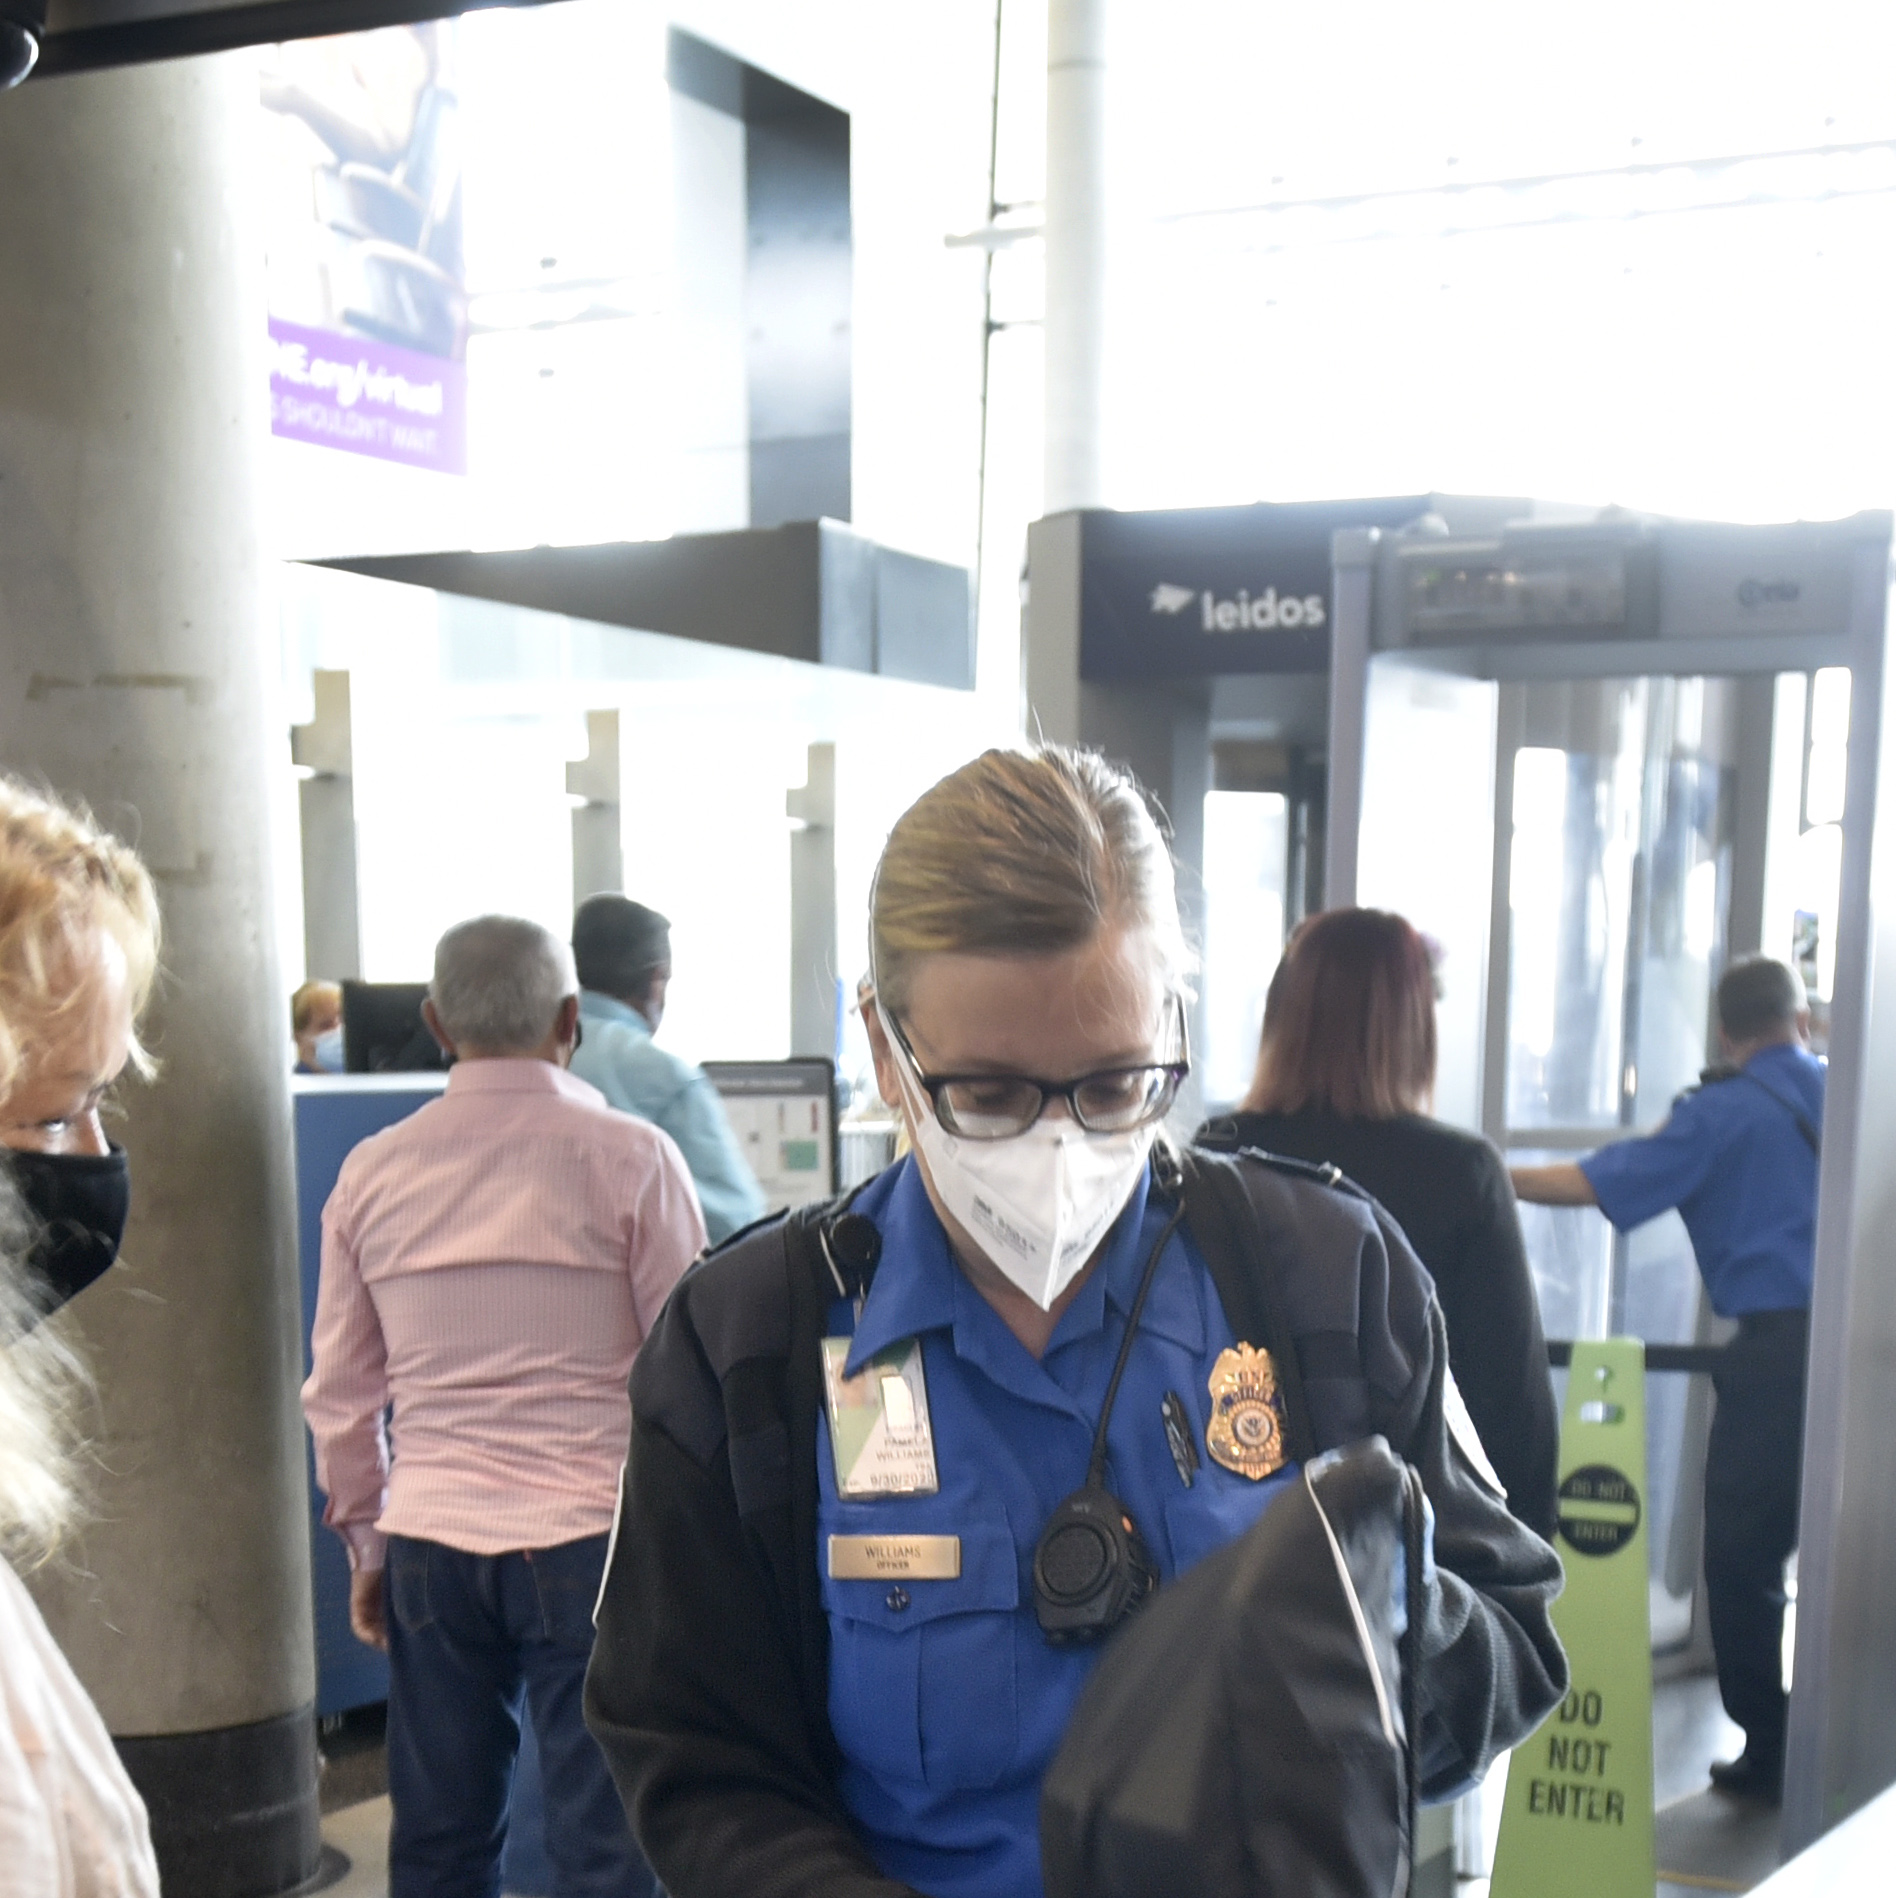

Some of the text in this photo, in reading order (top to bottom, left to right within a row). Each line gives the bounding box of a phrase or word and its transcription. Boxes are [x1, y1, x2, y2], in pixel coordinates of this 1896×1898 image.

[1201, 585, 1325, 631] leidos
[1571, 1478, 1625, 1500] DO NOT
[1574, 1521, 1619, 1541] ENTER
[865, 1544, 921, 1559] WILLIAMS
[1560, 1689, 1603, 1727] DO
[1549, 1734, 1610, 1776] NOT
[1529, 1779, 1624, 1826] ENTER
